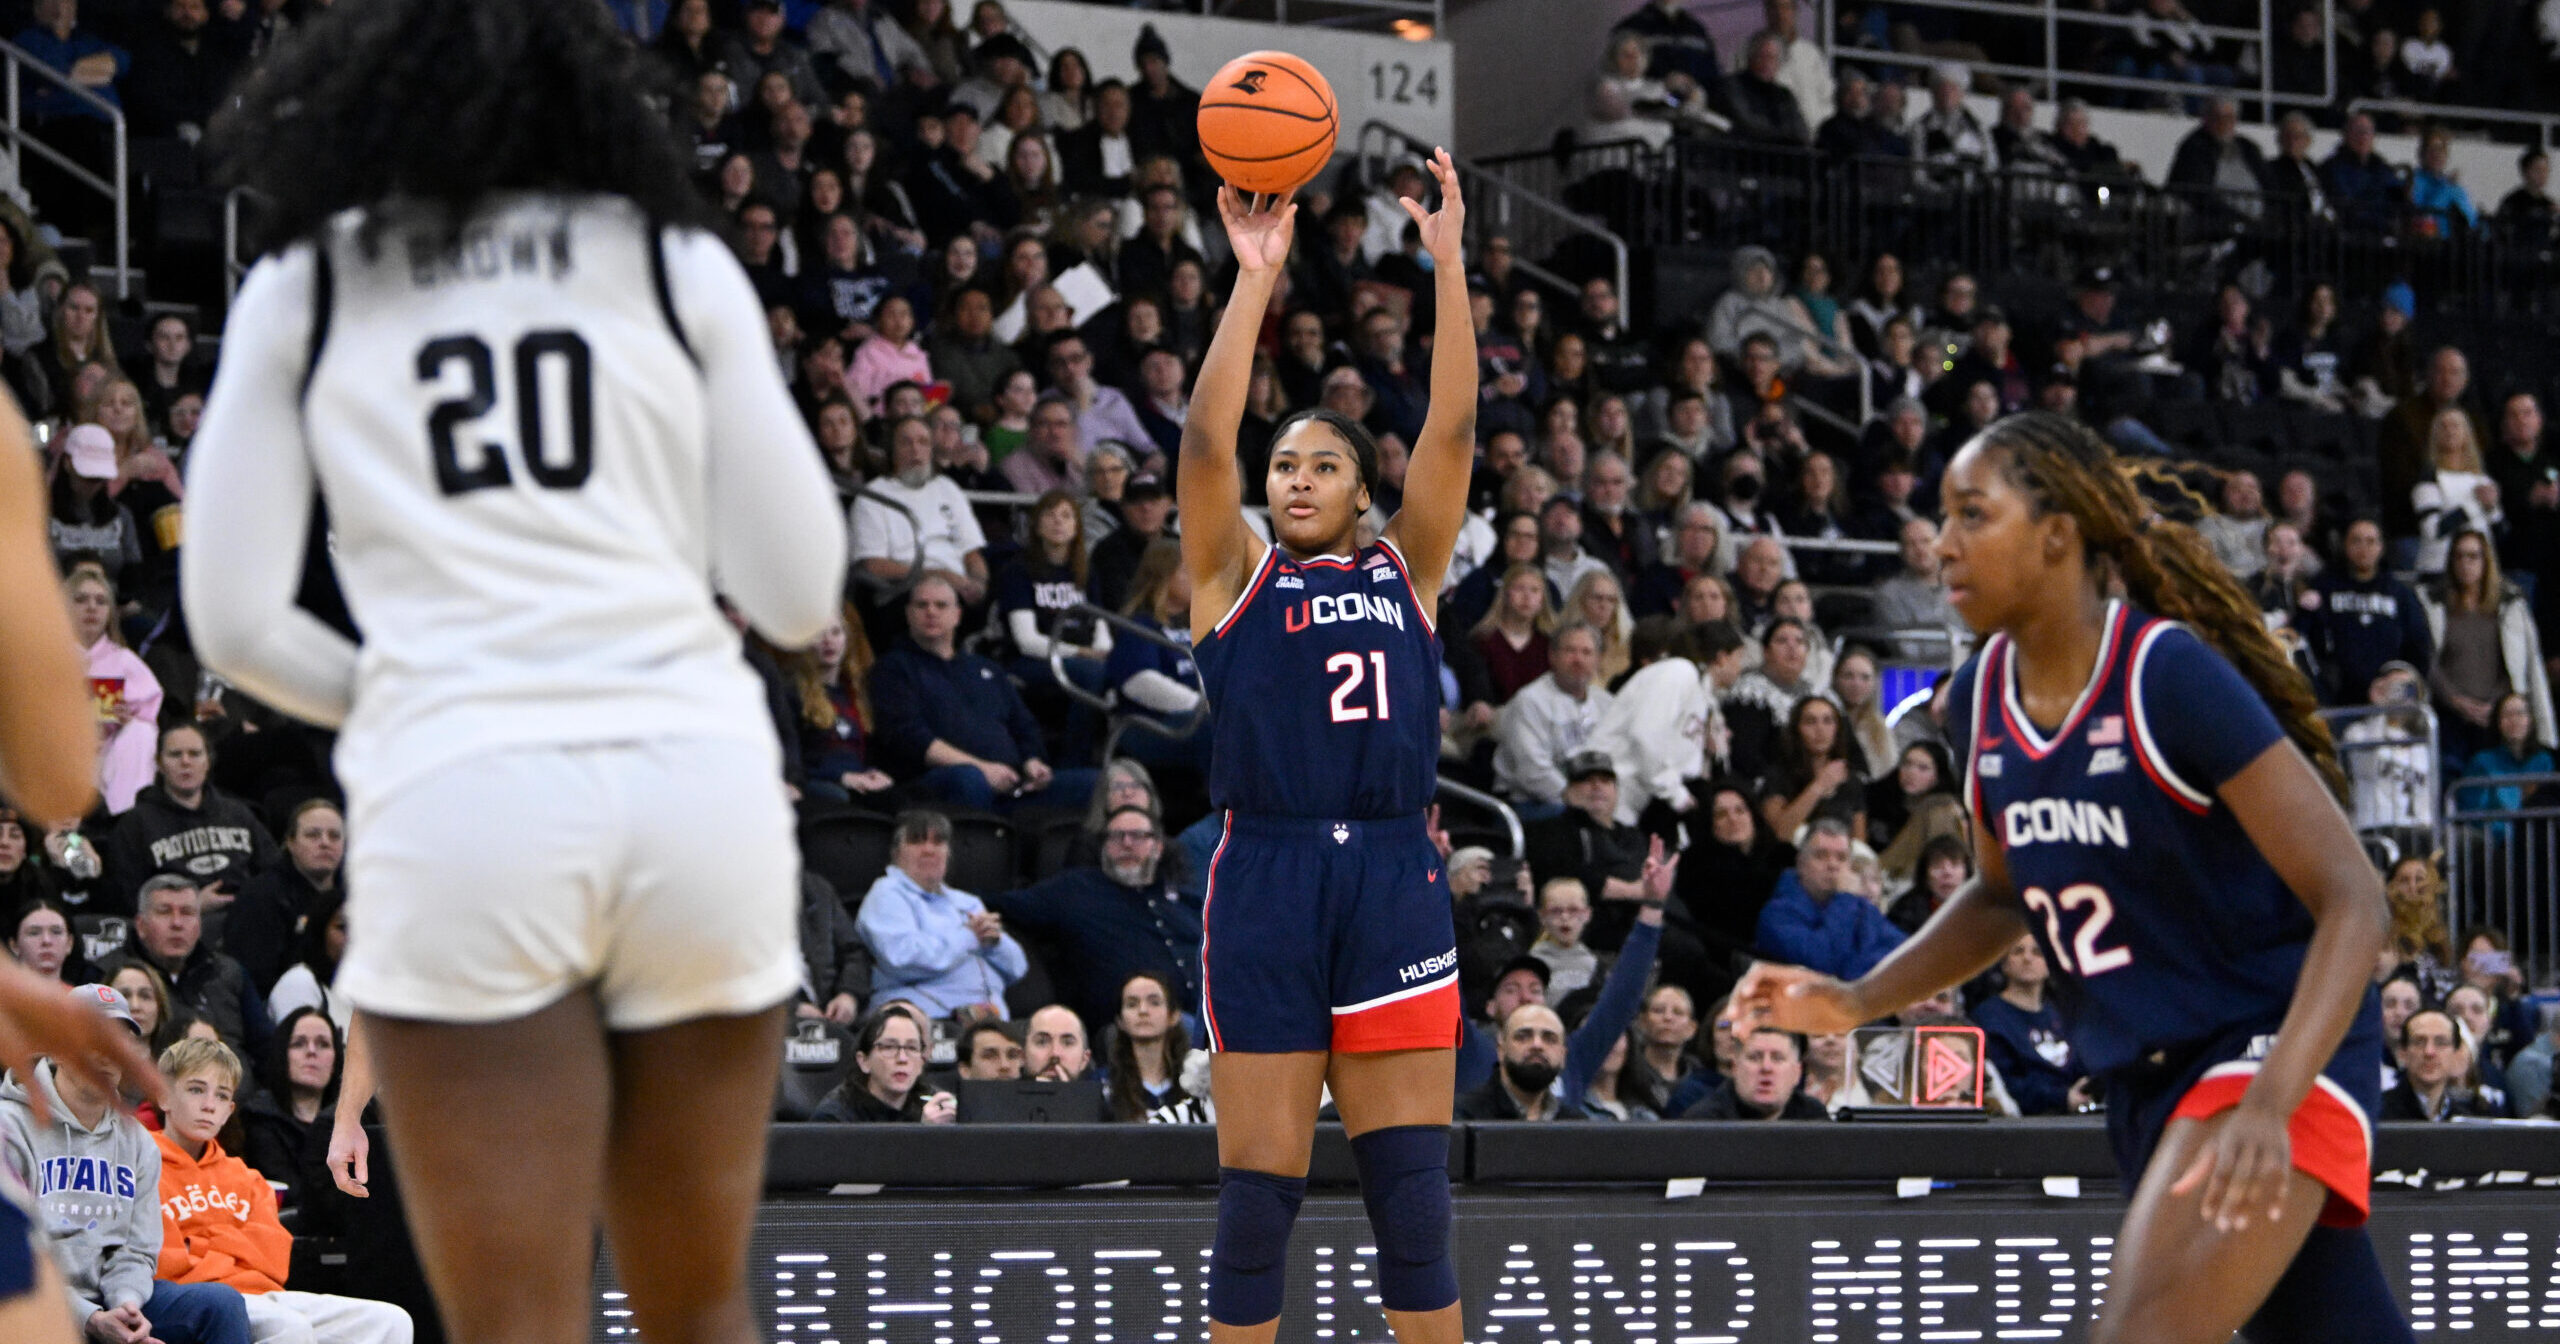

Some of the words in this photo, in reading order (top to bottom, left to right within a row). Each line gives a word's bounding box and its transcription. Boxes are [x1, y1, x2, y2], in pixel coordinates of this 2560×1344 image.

[1368, 62, 1440, 106] 124
[416, 329, 592, 497] 20
[1285, 592, 1404, 633] UCONN
[1325, 649, 1389, 723] 21
[150, 826, 252, 868] PROVIDENCE
[97, 987, 116, 1003] C
[776, 1249, 1212, 1344] RHOD
[1315, 1243, 1754, 1344] ISAND
